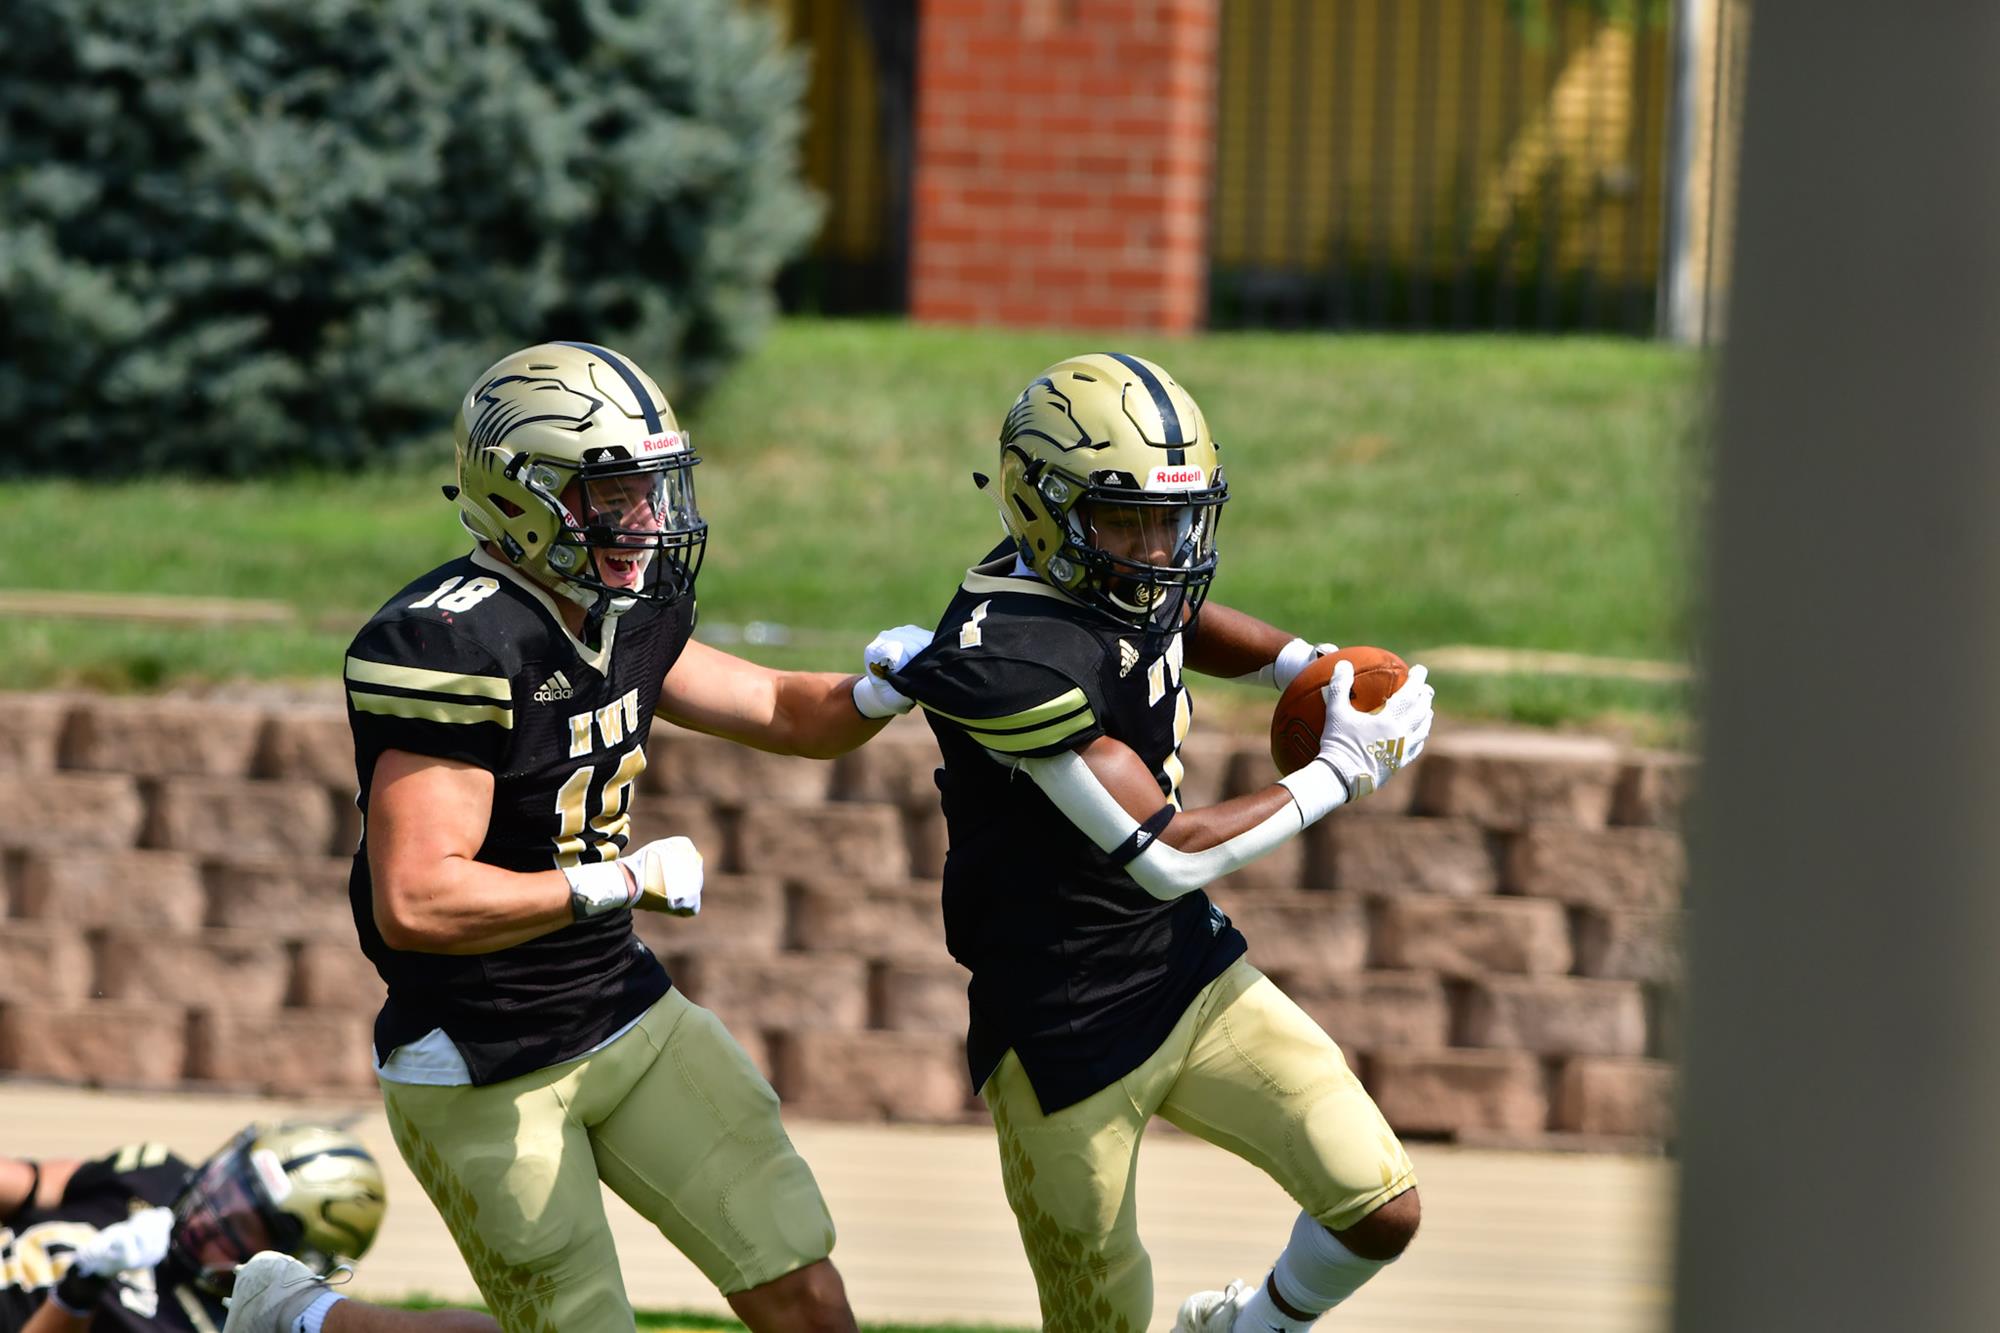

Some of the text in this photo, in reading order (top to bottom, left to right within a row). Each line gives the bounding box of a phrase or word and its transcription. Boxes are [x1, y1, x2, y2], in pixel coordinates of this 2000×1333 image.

[1156, 470, 1201, 483] Riddell
[408, 575, 501, 613] 18
[959, 599, 993, 650] 1
[568, 687, 640, 759] NWU
